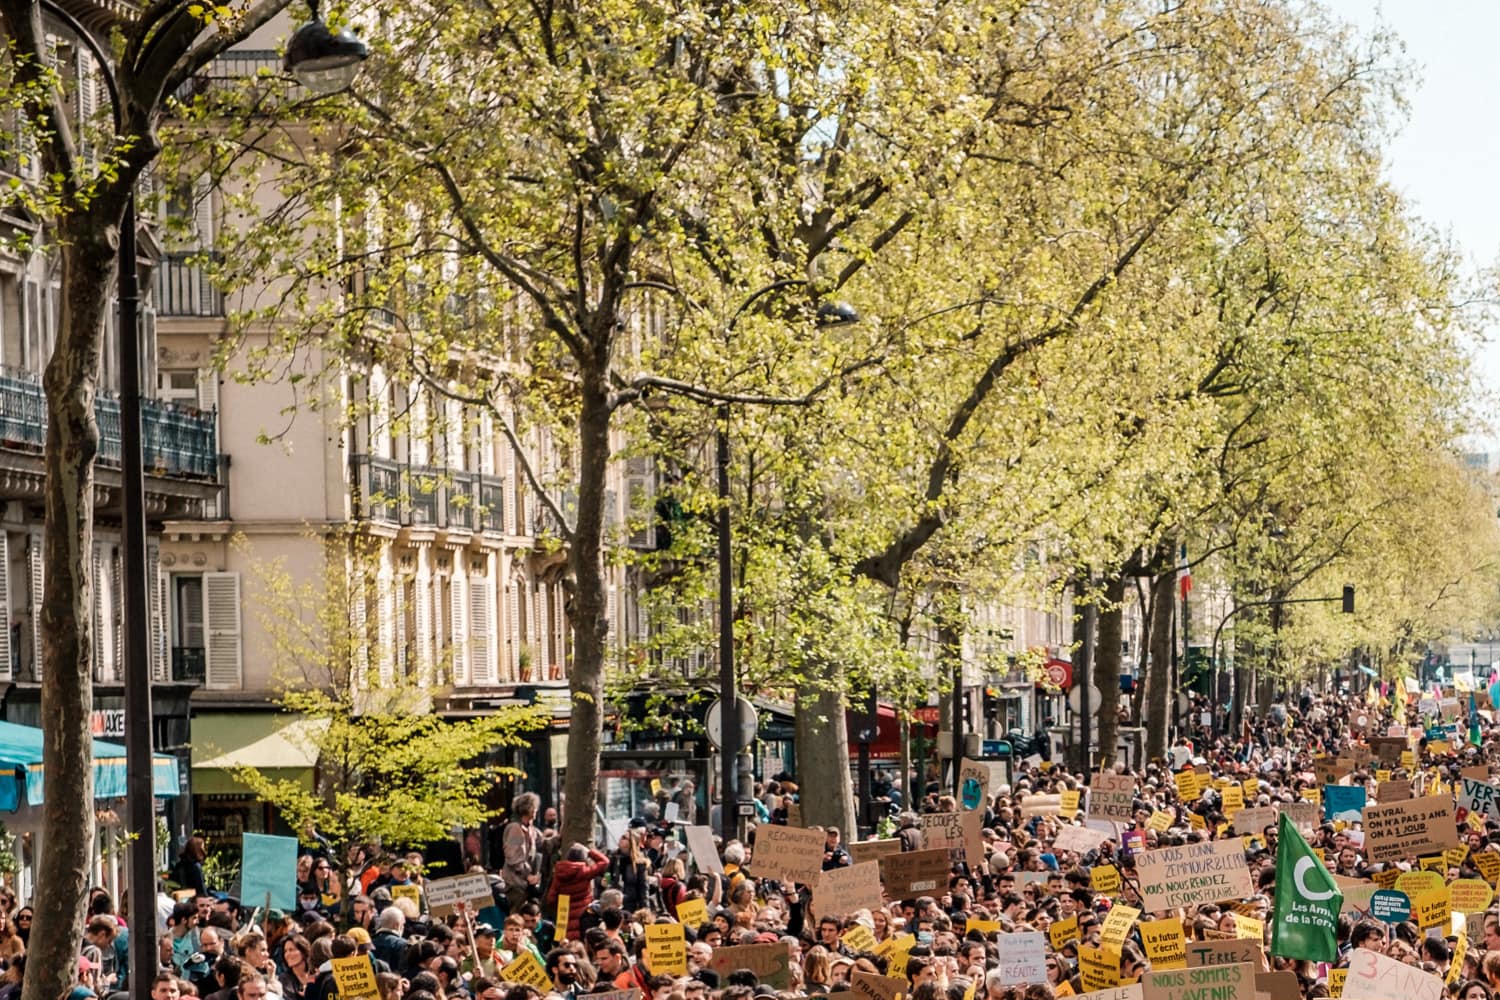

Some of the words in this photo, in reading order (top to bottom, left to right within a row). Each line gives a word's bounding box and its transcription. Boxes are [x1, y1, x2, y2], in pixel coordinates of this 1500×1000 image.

[1102, 804, 1132, 818] NEVER
[1471, 798, 1491, 813] DE
[1369, 821, 1382, 829] ON
[1402, 815, 1418, 823] PAS
[1429, 809, 1449, 819] ANS.
[1371, 831, 1384, 839] ON
[1403, 823, 1428, 833] JOUR.
[1189, 843, 1215, 857] DONNE
[1144, 881, 1164, 894] VOUS
[1190, 875, 1230, 889] RENDEZ
[1166, 895, 1182, 908] LES
[1292, 901, 1308, 912] Les
[1285, 914, 1299, 924] de
[1301, 915, 1310, 924] la
[1153, 970, 1186, 987] NOUS
[1189, 966, 1242, 985] SOMMES
